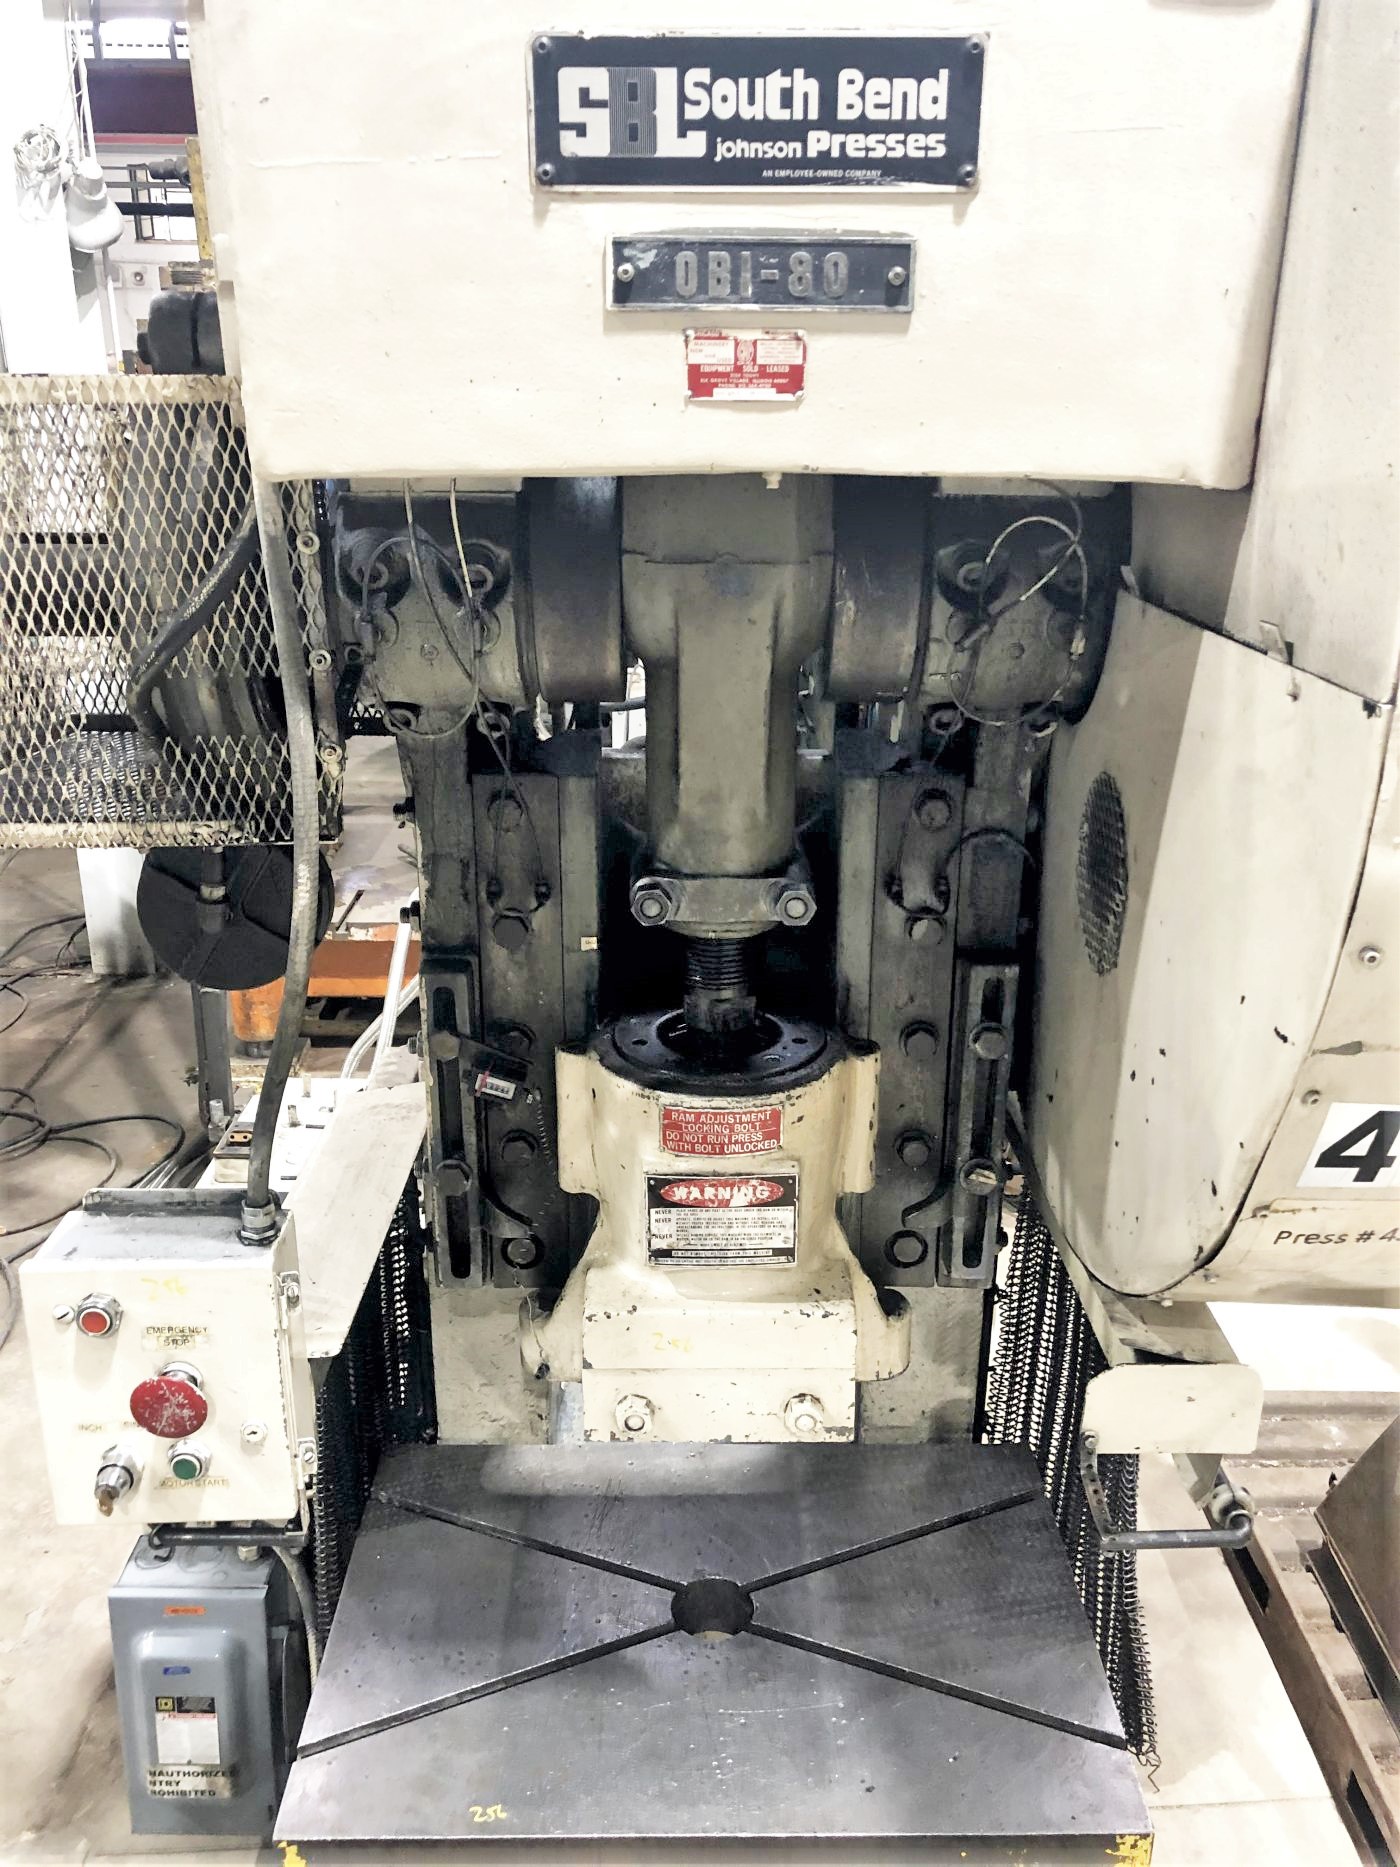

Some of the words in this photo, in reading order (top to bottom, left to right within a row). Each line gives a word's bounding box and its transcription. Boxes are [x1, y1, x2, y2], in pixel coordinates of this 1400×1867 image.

[684, 68, 819, 122] South
[837, 68, 949, 121] Bend
[558, 66, 707, 158] SBL
[714, 136, 802, 162] johnson
[806, 130, 946, 158] Presses
[762, 169, 773, 178] AN
[845, 169, 882, 178] COMPANY
[671, 1111, 695, 1122] RAM
[699, 1111, 772, 1124] ADJUSTMENT
[682, 1123, 730, 1134] LOCKING
[734, 1122, 761, 1133] BOLT
[665, 1131, 680, 1141] DO
[682, 1133, 704, 1143] NOT
[707, 1134, 729, 1144] RUN
[731, 1132, 763, 1143] PRESS
[666, 1140, 692, 1152] WITH
[694, 1144, 721, 1154] BOLT
[723, 1139, 778, 1154] UNLOCKED
[1273, 1230, 1349, 1245] Press
[146, 1326, 208, 1335] EMERGENCY
[163, 1338, 190, 1347] STOP
[469, 1804, 507, 1822] 256
